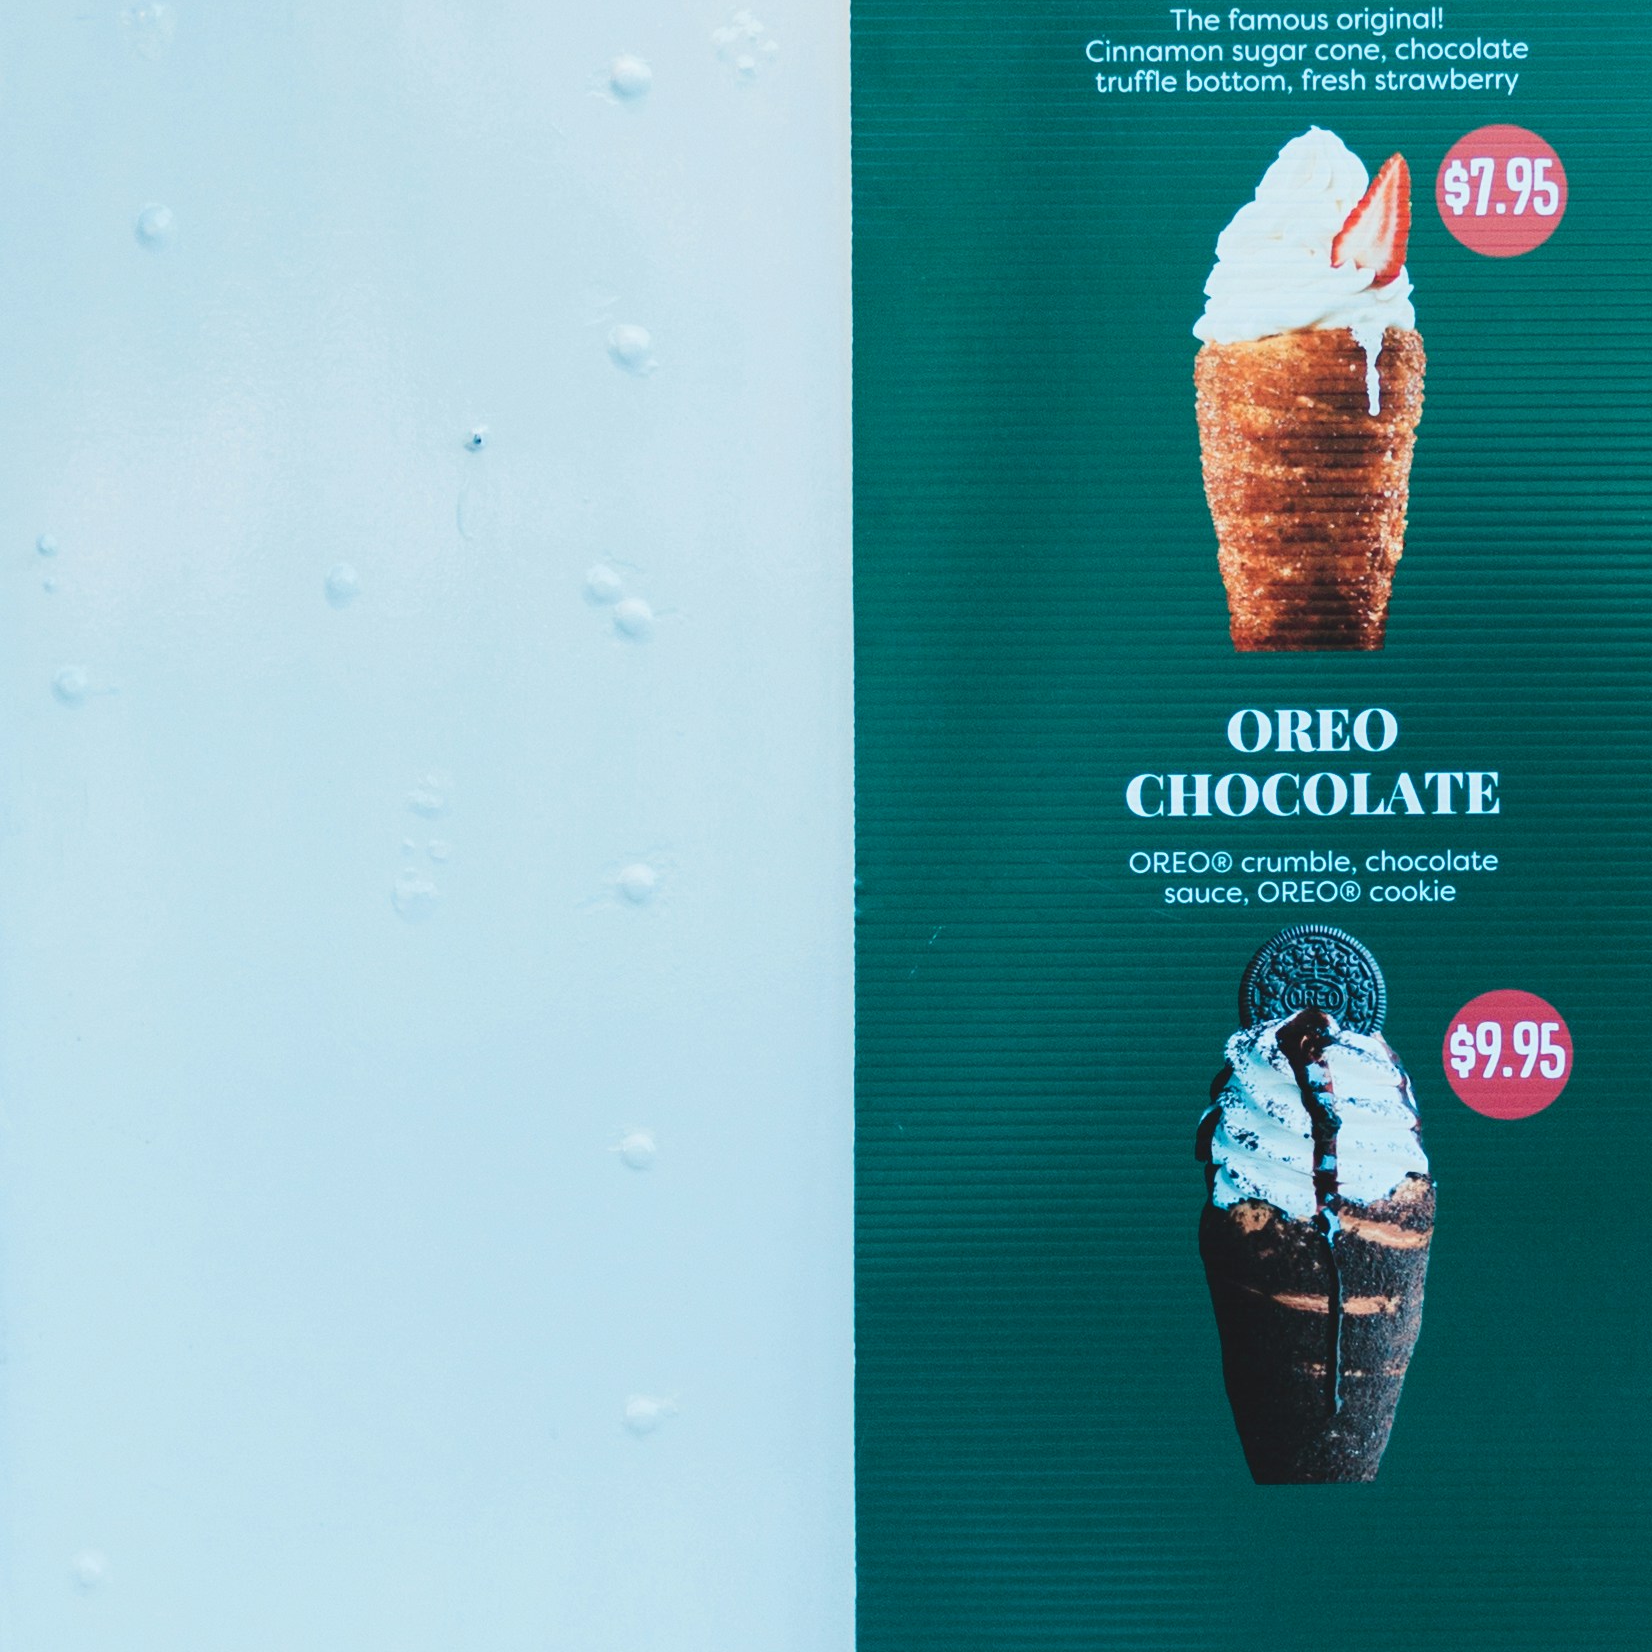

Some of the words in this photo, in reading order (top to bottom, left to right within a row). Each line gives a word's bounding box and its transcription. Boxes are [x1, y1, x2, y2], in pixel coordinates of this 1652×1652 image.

[1170, 8, 1221, 31] The
[1228, 8, 1328, 31] famous
[1337, 7, 1443, 36] original!
[1086, 40, 1223, 63] Cinnamon
[1232, 40, 1305, 67] sugar
[1315, 41, 1386, 63] cone,
[1395, 37, 1529, 60] chocolate
[1096, 70, 1177, 94] truffle
[1186, 70, 1293, 94] bottom,
[1302, 69, 1366, 91] fresh
[1375, 69, 1520, 95] strawberry
[1445, 158, 1558, 215] $7.95
[1227, 708, 1398, 753] OREO
[1125, 771, 1501, 817] CHOCOLATE
[1241, 851, 1358, 876] crumble,
[1365, 850, 1499, 872] chocolate
[1164, 886, 1249, 906] sauce,
[1369, 879, 1456, 903] cookie
[1290, 990, 1341, 1006] OREO
[1450, 1021, 1565, 1078] $9.95
